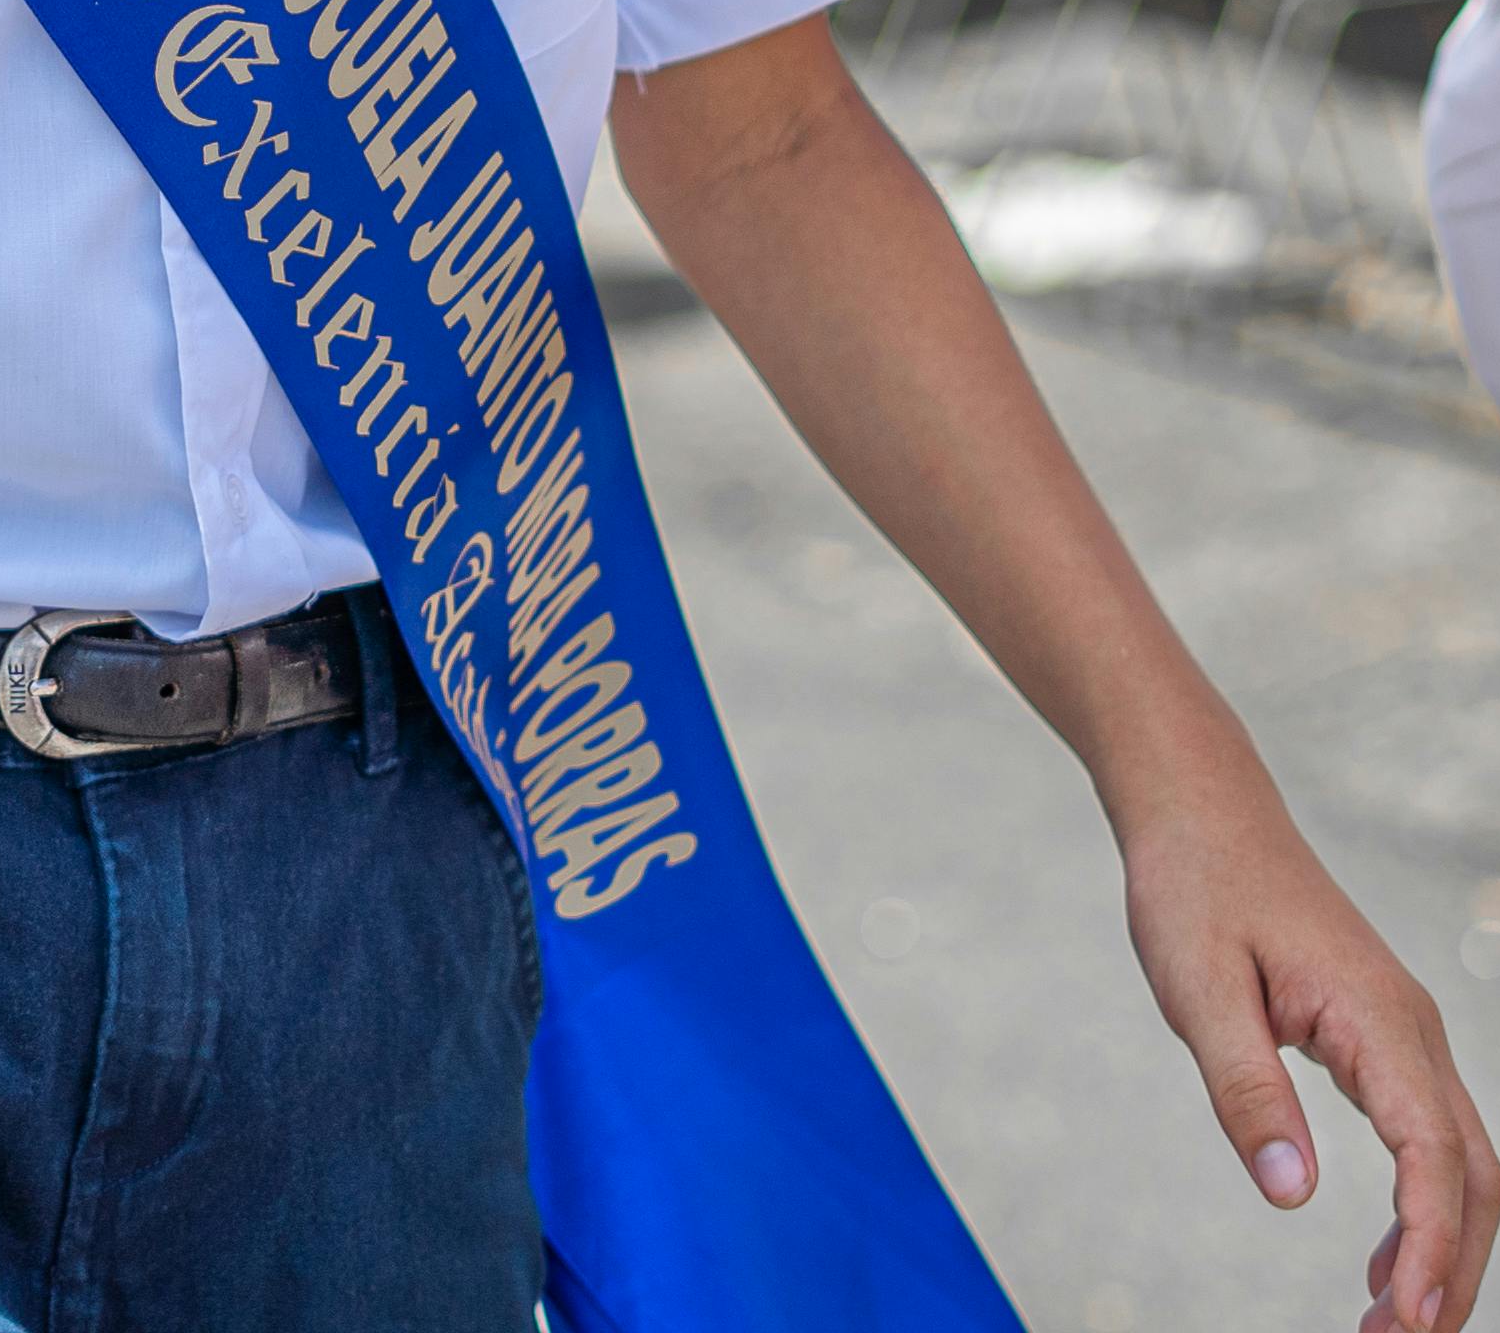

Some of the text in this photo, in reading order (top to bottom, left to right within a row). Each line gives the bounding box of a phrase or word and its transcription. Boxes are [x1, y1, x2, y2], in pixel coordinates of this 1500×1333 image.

[154, 3, 461, 564] Excelencia
[408, 151, 574, 494] JUANITO
[504, 427, 601, 686] MORA
[510, 611, 698, 920] PORRAS
